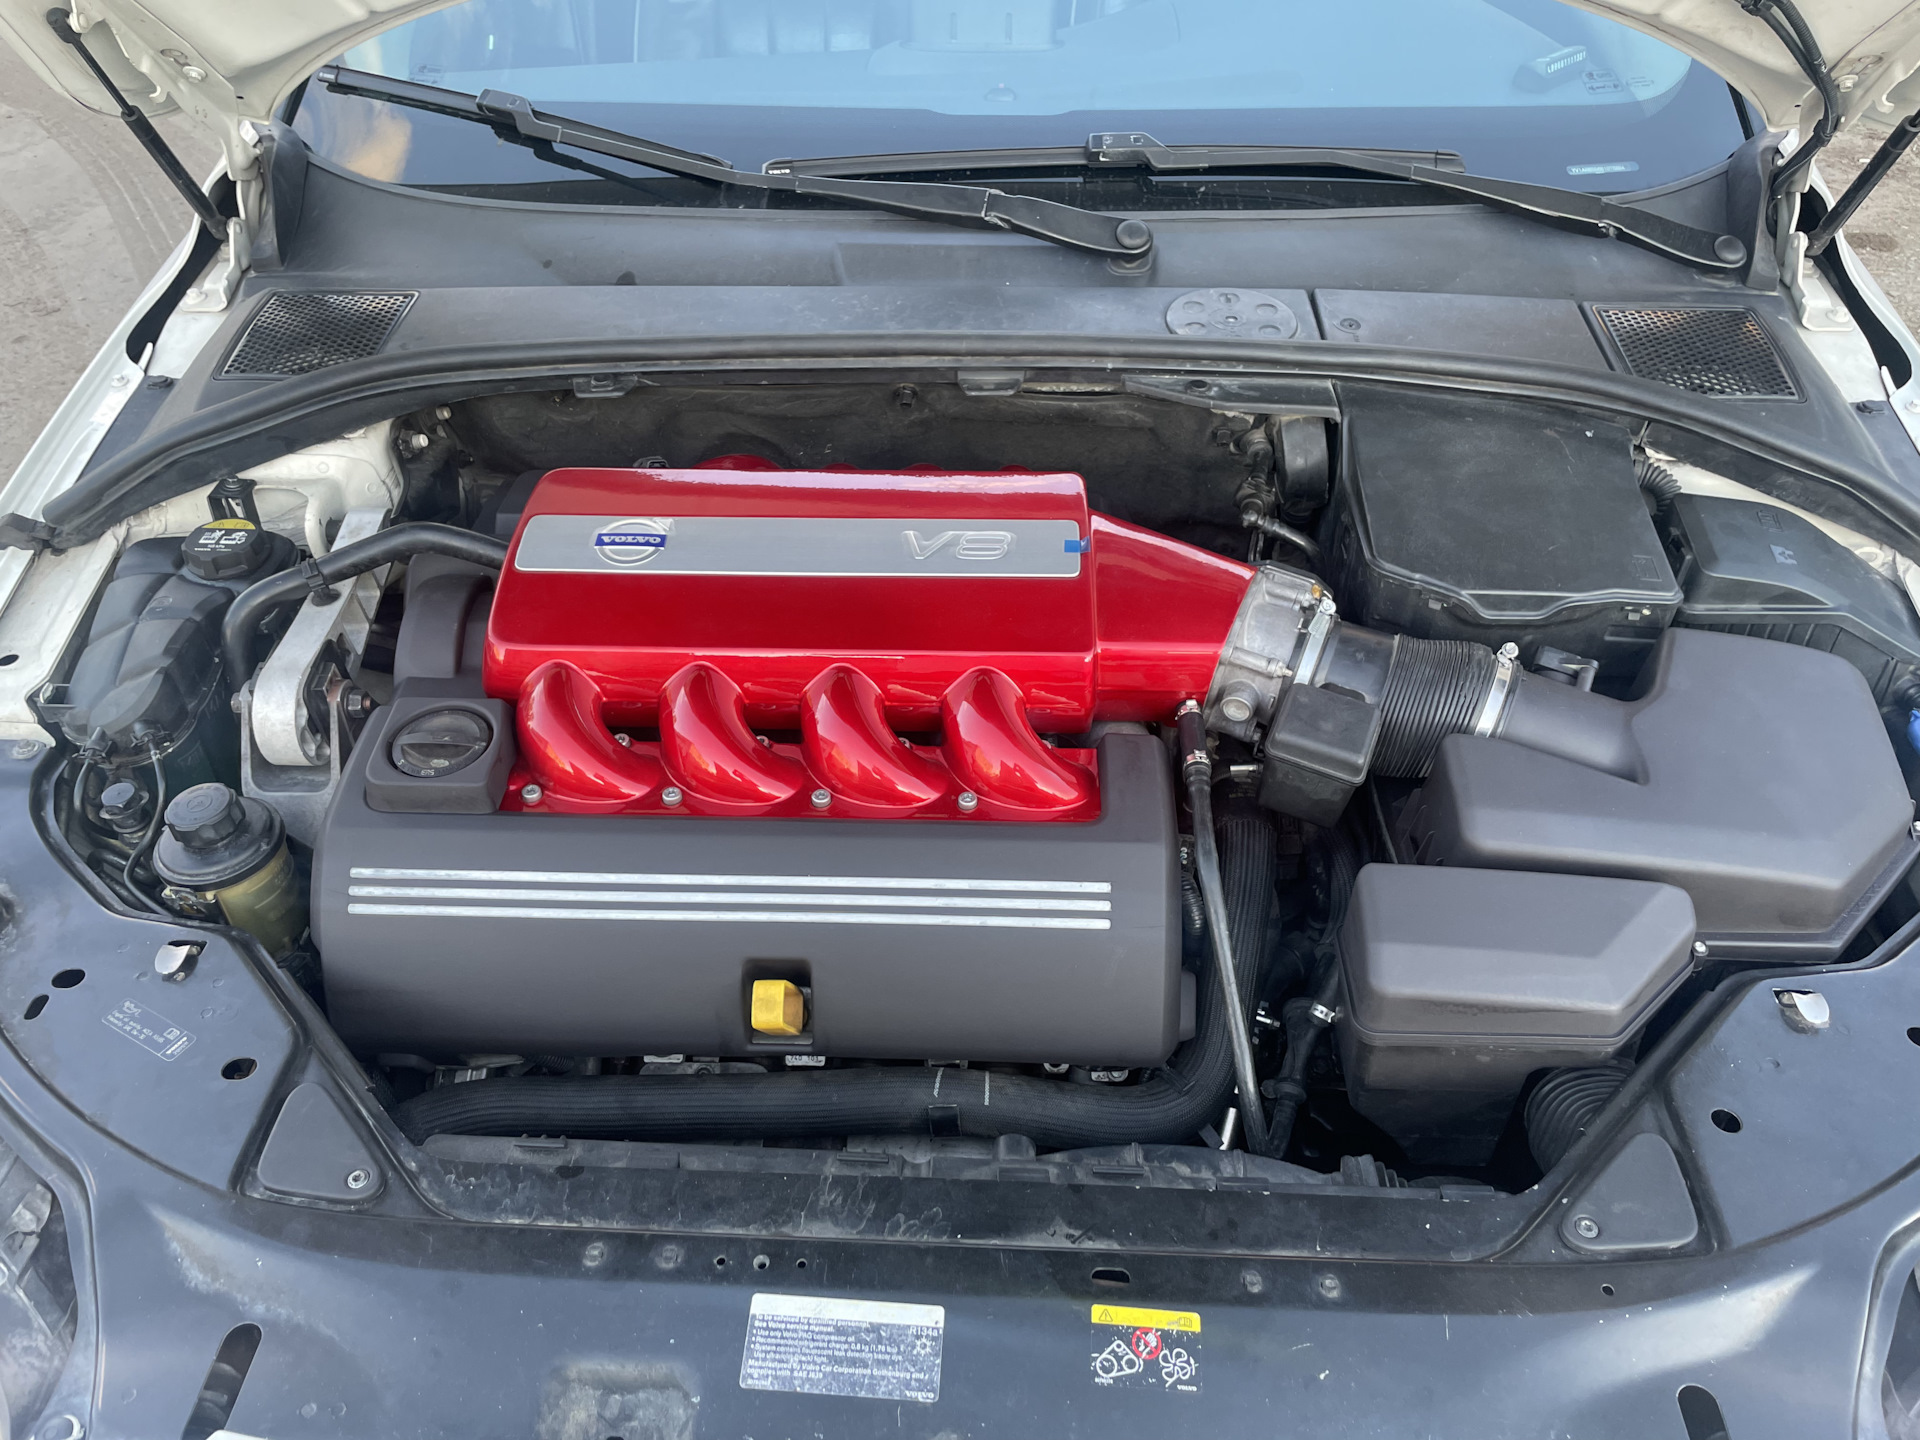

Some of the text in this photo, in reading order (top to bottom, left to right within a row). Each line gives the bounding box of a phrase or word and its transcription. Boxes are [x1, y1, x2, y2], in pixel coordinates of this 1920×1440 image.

[600, 530, 1013, 561] VOLVO V8
[773, 1314, 800, 1322] serviced
[809, 1324, 835, 1332] manual.
[909, 1326, 938, 1336] R134a
[813, 1333, 846, 1341] compressor
[846, 1350, 872, 1358] detection
[746, 1367, 775, 1375] complies
[747, 1359, 792, 1369] Manufactured
[801, 1363, 820, 1371] Volvo
[833, 1365, 871, 1374] Corporation
[872, 1368, 911, 1378] Gothenburg
[905, 1390, 934, 1399] VOLVO
